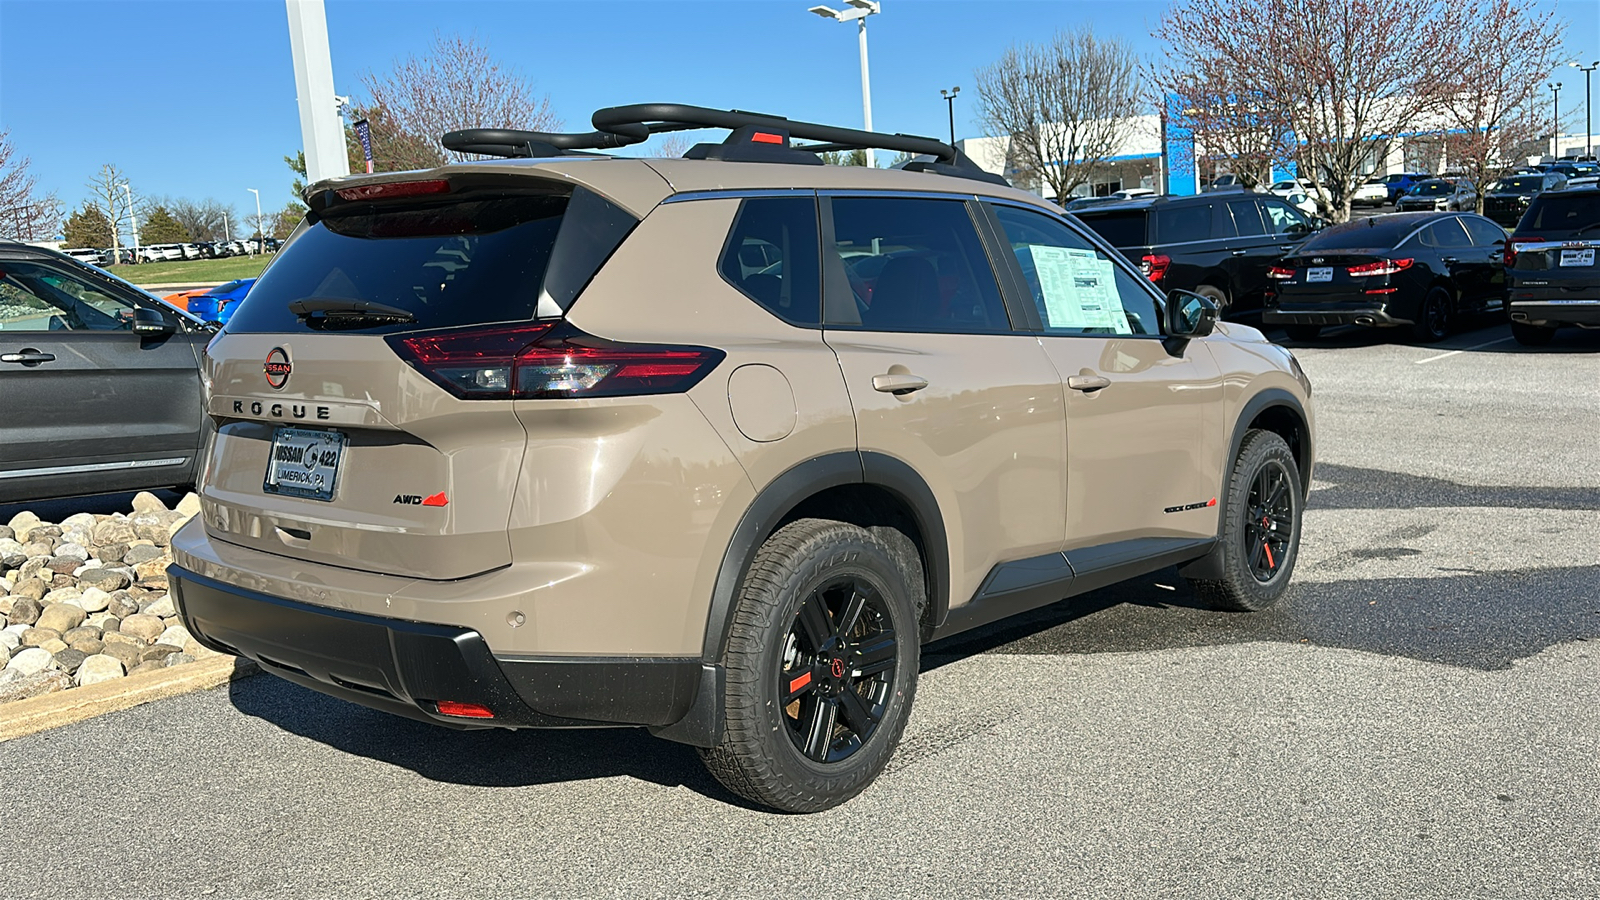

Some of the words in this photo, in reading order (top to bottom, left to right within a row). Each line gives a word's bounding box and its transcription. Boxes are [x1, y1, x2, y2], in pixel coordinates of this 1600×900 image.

[265, 363, 290, 373] SSAN
[233, 400, 330, 420] ROGUE
[275, 443, 304, 463] NISSAN
[318, 450, 337, 468] 422
[277, 469, 313, 485] LIMERICK,
[315, 474, 326, 487] PA
[393, 494, 423, 505] AWD
